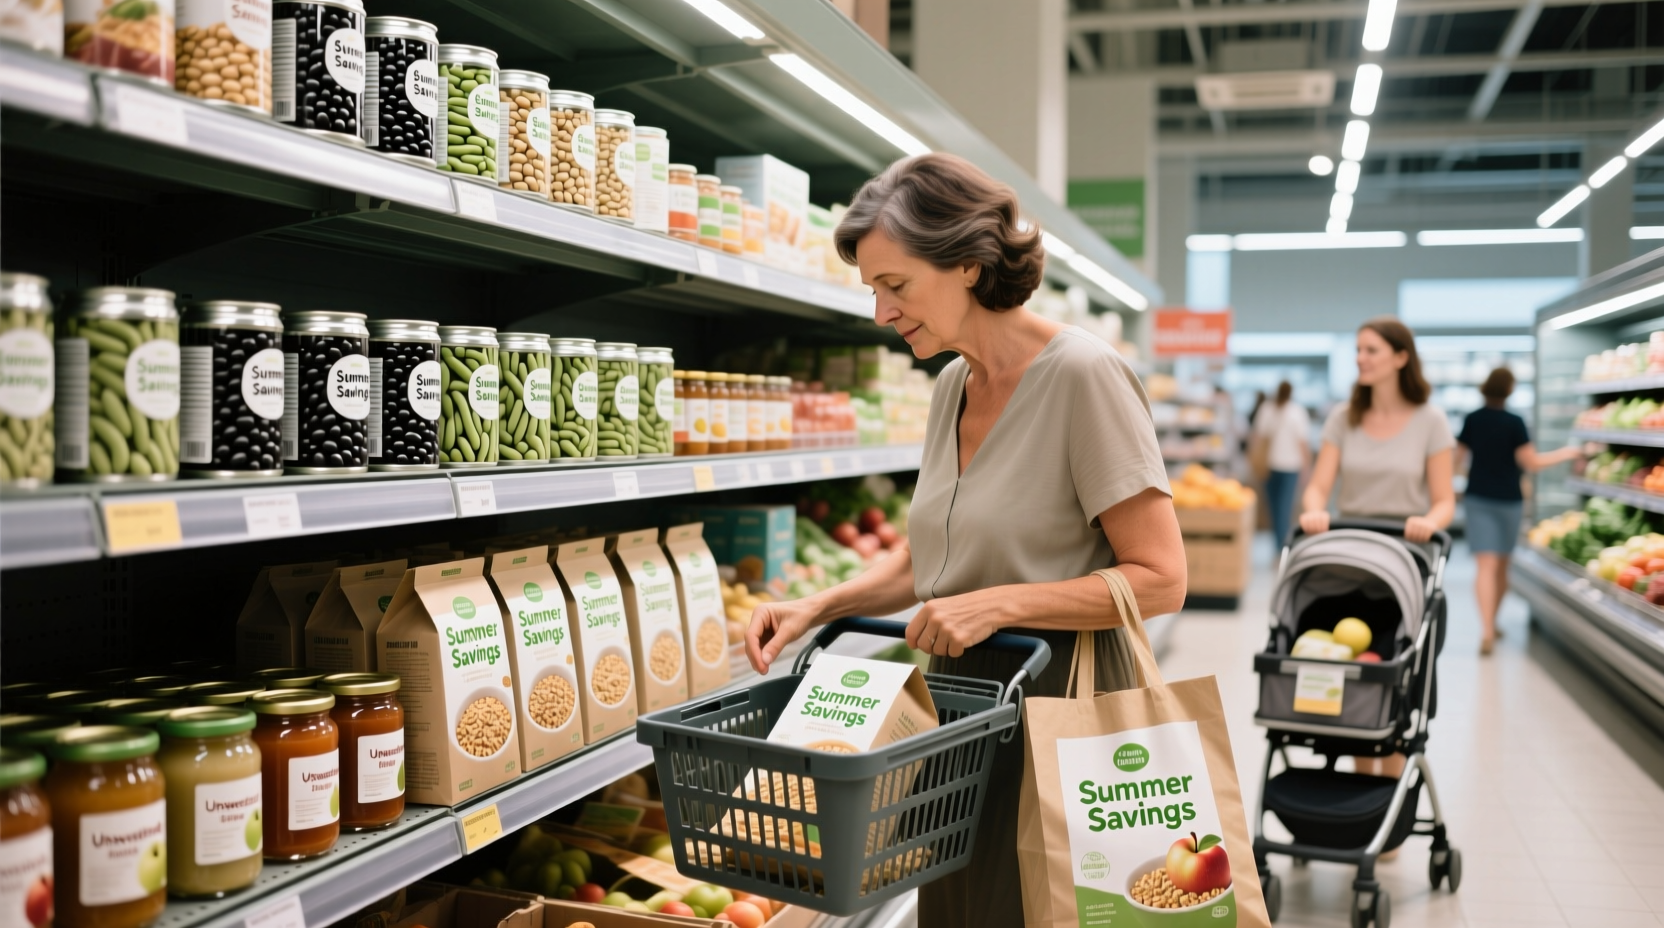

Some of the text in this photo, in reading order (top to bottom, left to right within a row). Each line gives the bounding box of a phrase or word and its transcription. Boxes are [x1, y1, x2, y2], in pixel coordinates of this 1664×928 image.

[518, 607, 561, 627] Summer
[445, 622, 498, 646] Summer
[523, 625, 564, 647] Savings
[451, 644, 501, 669] Savings
[807, 685, 881, 711] Summer
[800, 701, 867, 728] Savings
[1079, 774, 1193, 805] Summer
[1088, 801, 1196, 833] Savings
